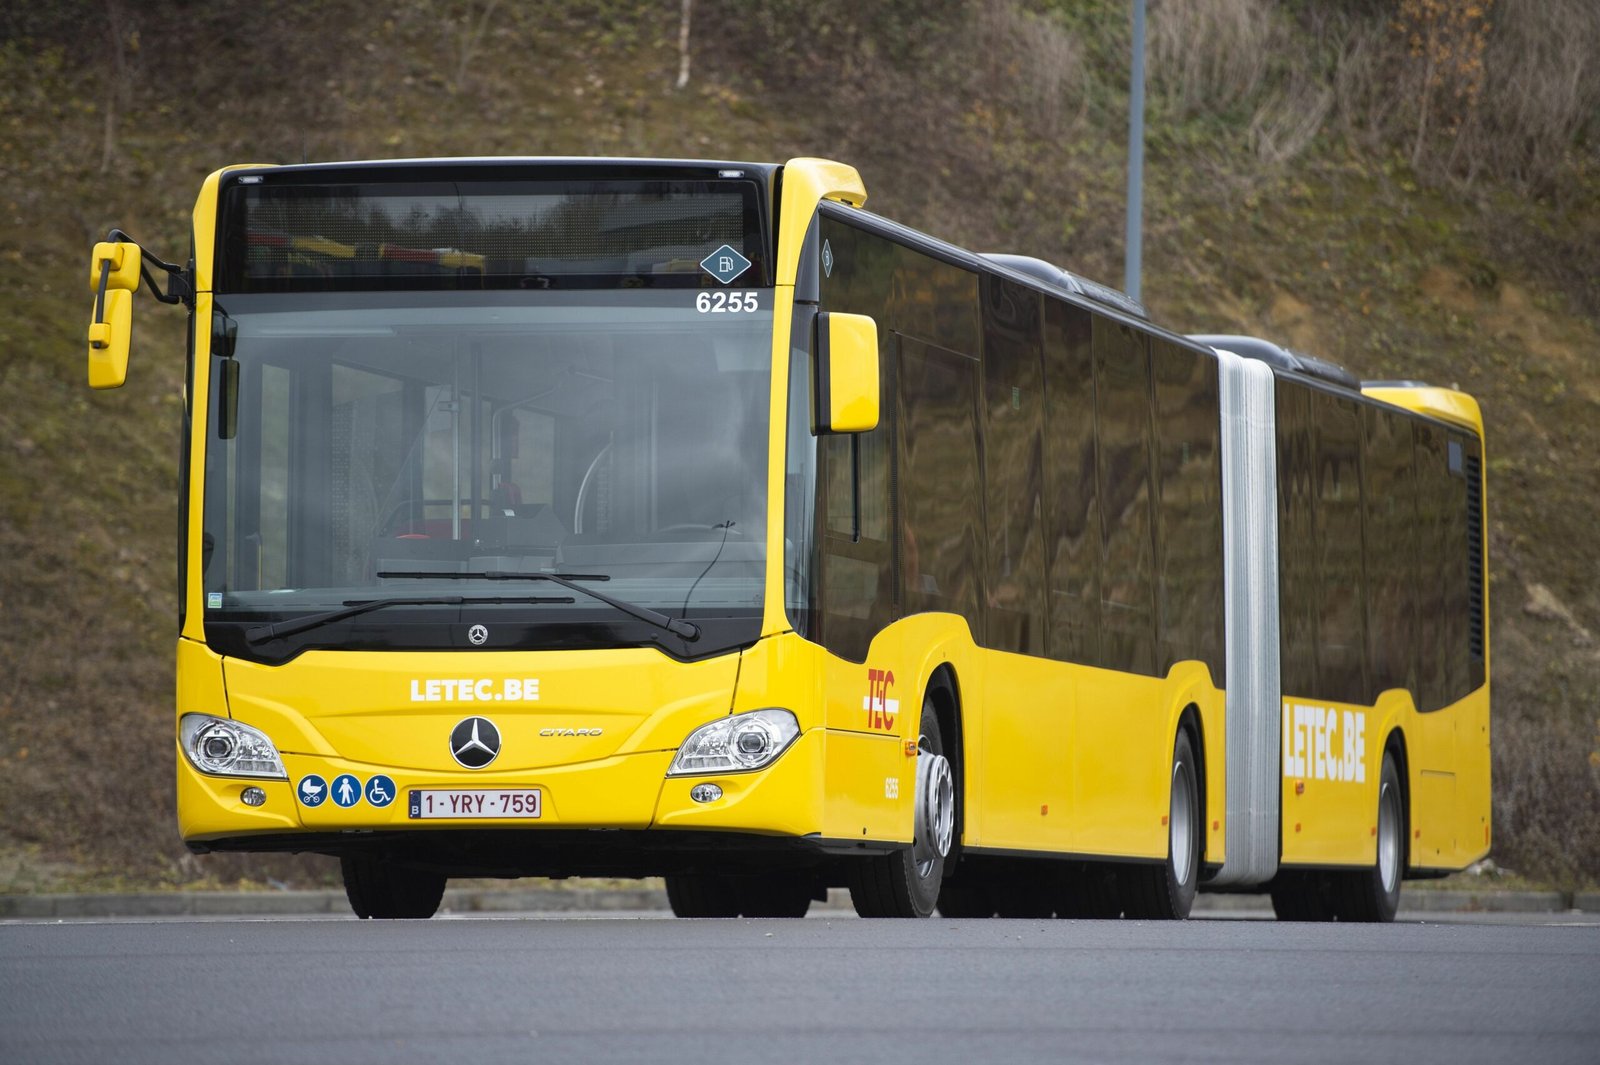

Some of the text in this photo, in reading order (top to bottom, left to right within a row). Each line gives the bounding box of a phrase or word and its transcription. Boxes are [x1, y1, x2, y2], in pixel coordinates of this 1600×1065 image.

[696, 292, 758, 313] 6255
[410, 679, 540, 701] LETEC.BE
[868, 668, 895, 731] TEC
[539, 727, 603, 737] CITARO
[1284, 703, 1366, 784] LETEC.BE
[885, 777, 898, 800] 6255
[411, 805, 420, 815] B
[425, 794, 537, 814] 1-YRY-759
